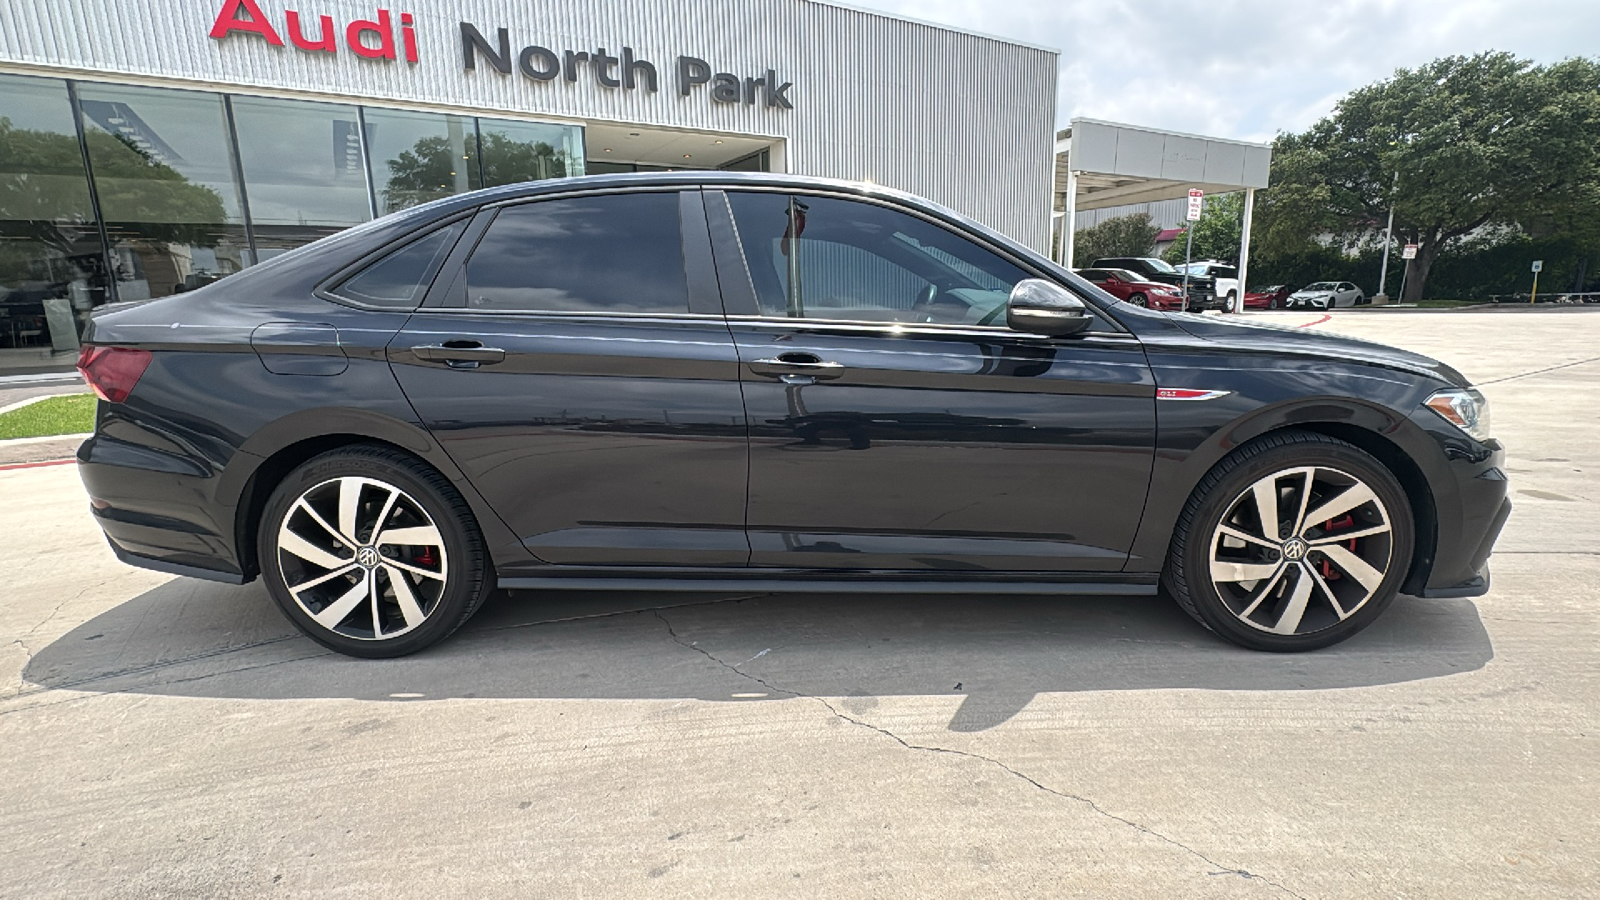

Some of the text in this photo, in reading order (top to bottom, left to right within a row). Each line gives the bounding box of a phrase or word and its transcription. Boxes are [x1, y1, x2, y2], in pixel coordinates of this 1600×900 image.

[209, 0, 418, 63] Audi
[460, 22, 793, 109] North Park
